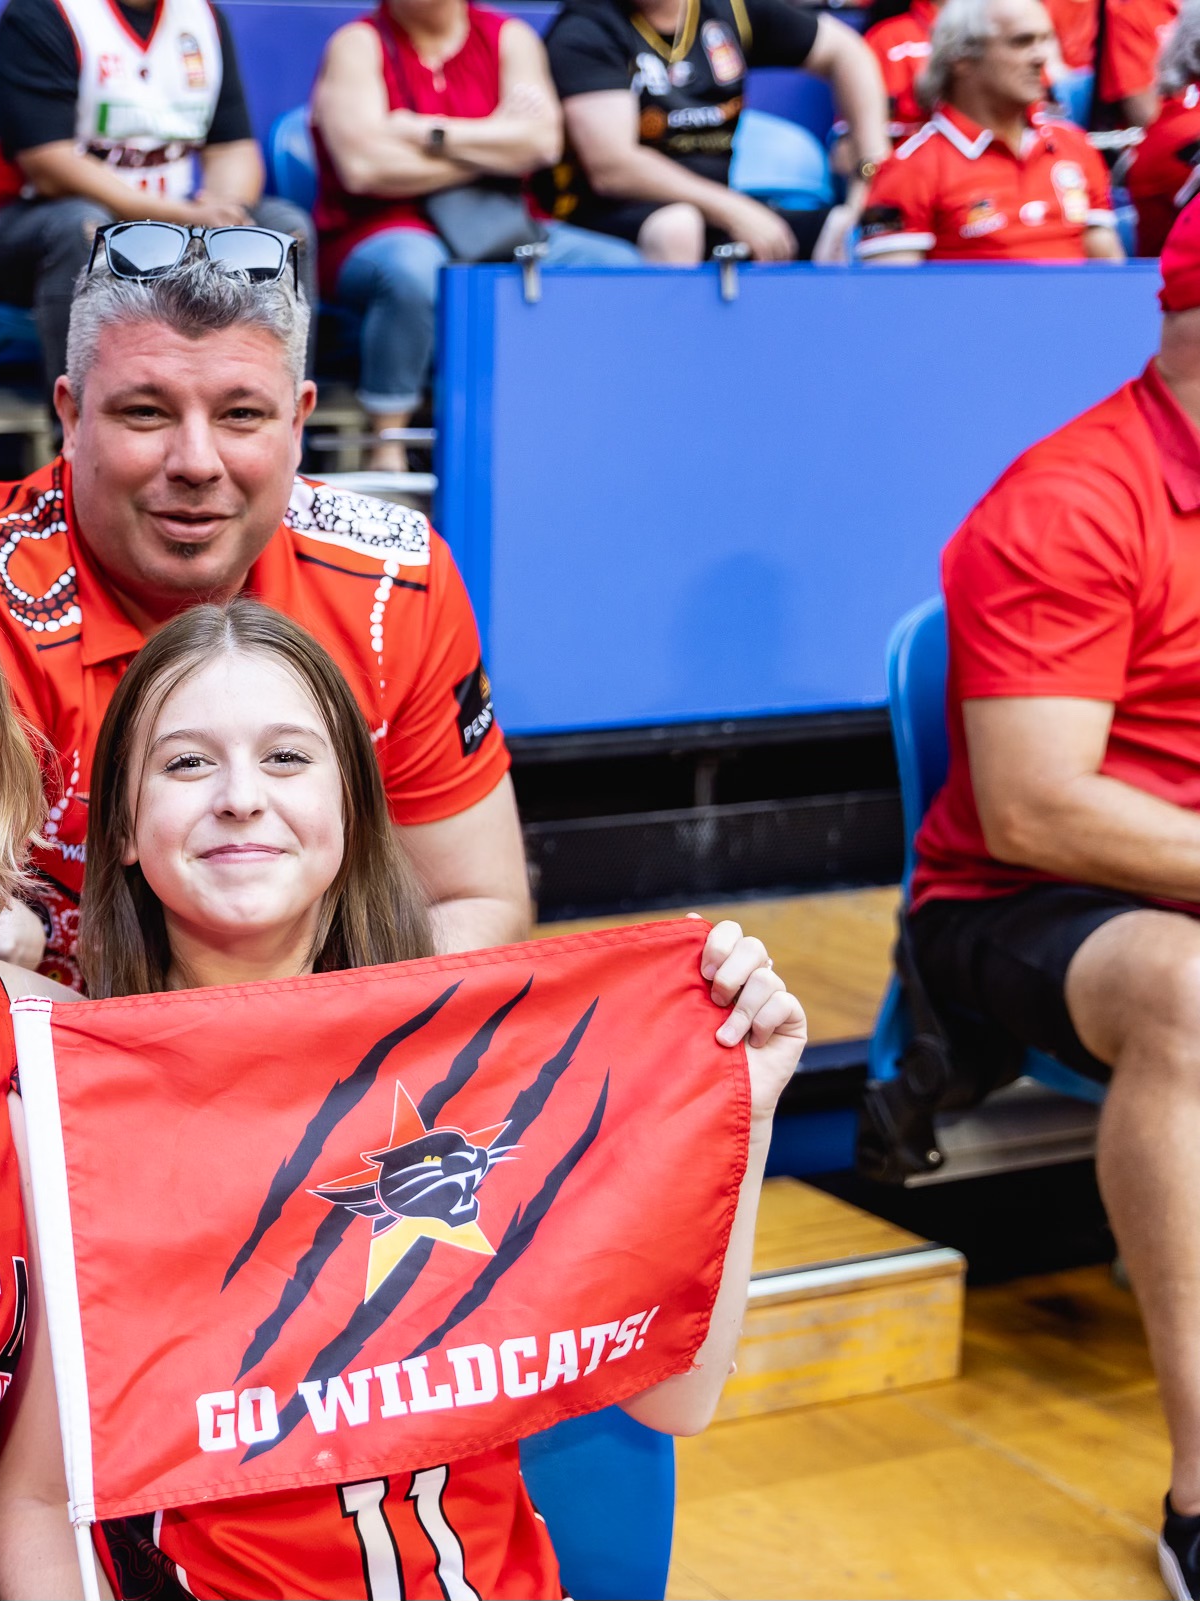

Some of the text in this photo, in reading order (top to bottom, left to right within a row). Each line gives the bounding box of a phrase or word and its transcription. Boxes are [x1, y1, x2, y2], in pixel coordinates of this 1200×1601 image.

[196, 1305, 660, 1452] GO WILDCATS!
[336, 1463, 484, 1601] 11
